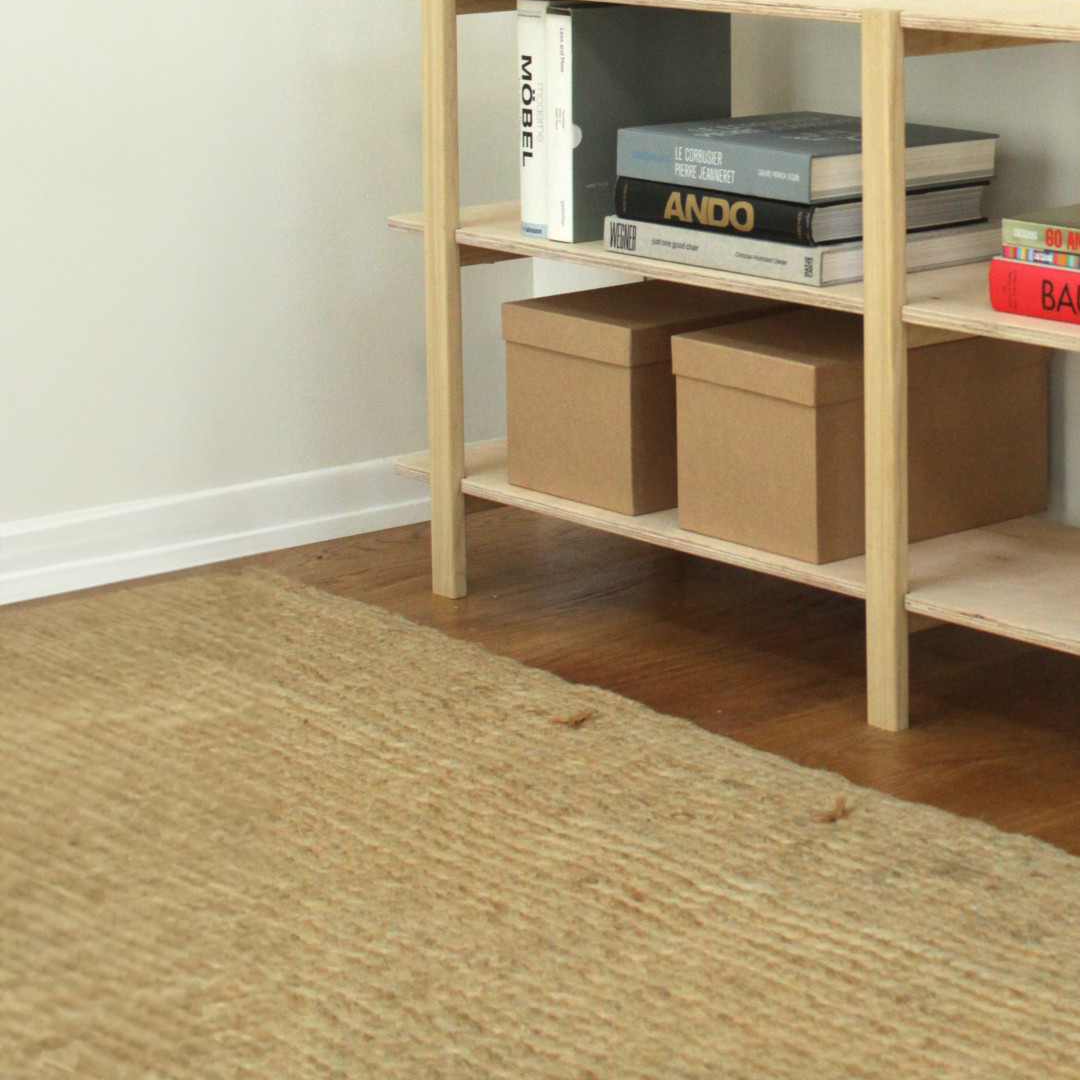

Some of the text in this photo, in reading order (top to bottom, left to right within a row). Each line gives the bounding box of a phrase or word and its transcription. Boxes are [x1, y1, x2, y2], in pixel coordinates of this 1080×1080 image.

[521, 54, 536, 167] MÖBEL
[674, 146, 683, 161] LE
[685, 149, 723, 166] CORBUSIER
[674, 162, 735, 185] PIERRE JEANNERET
[663, 191, 755, 232] ANDO
[610, 222, 637, 252] WEGNER
[1045, 227, 1063, 248] 60
